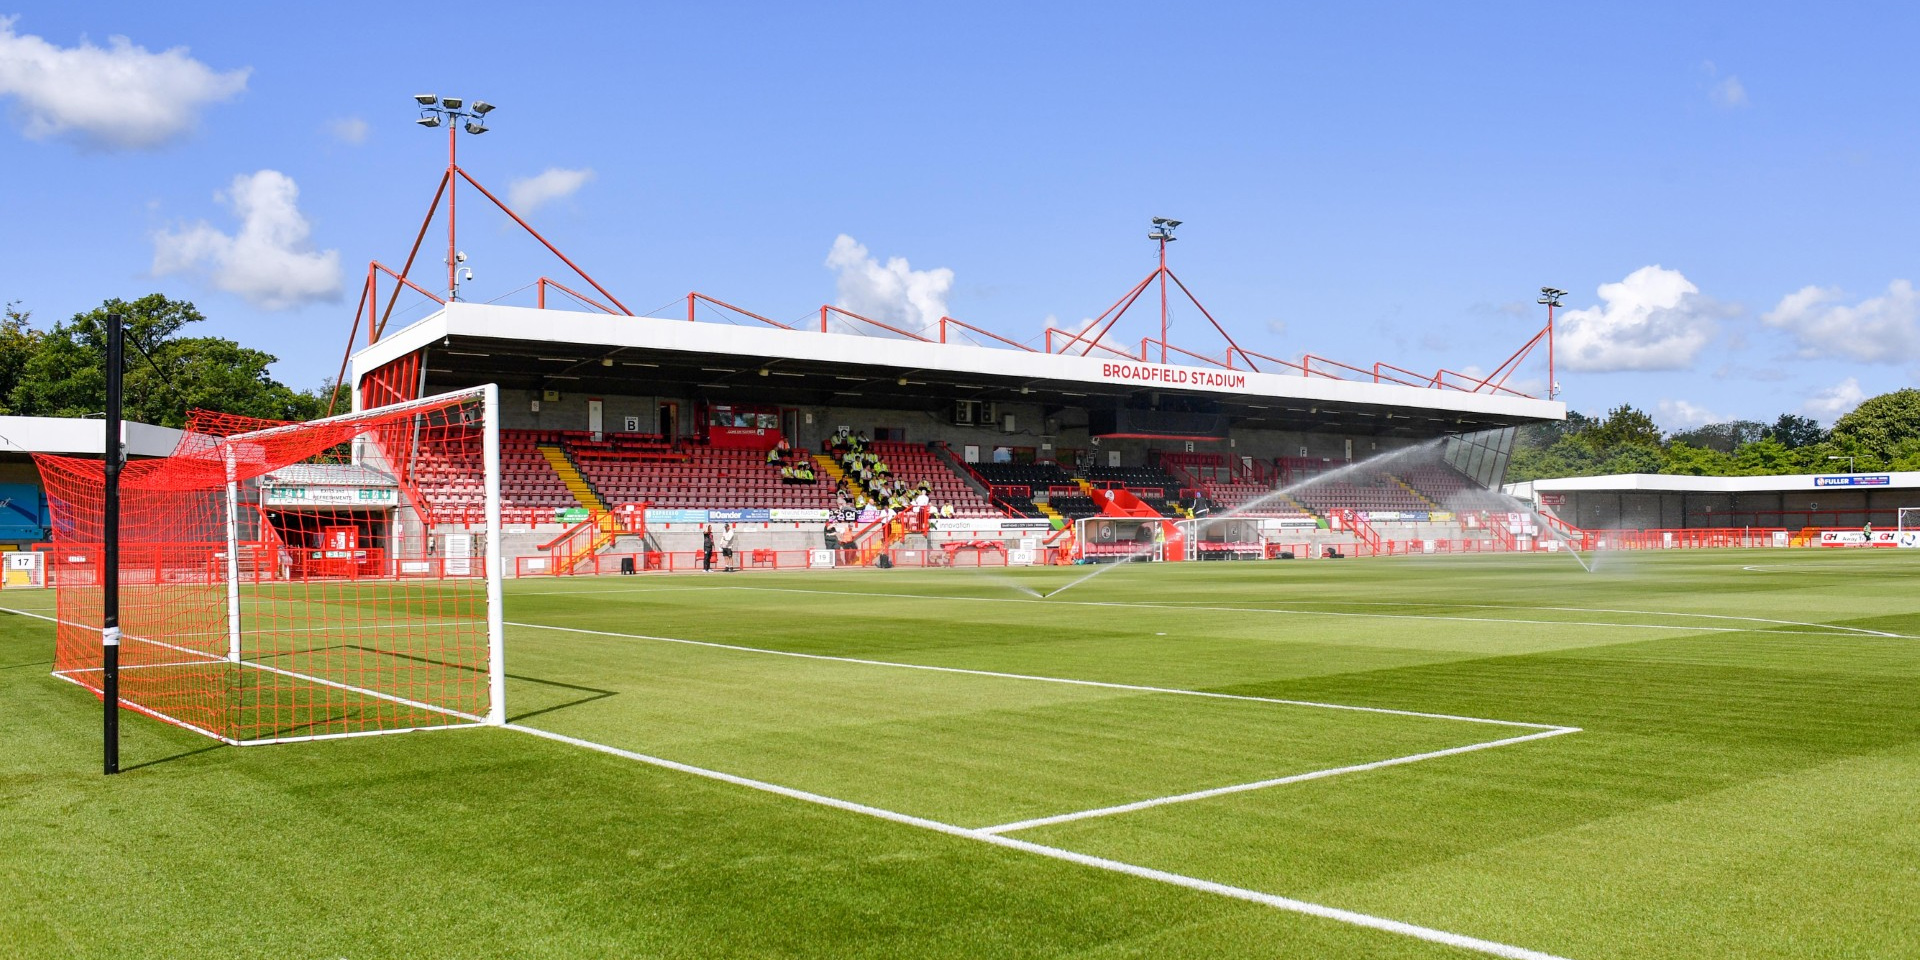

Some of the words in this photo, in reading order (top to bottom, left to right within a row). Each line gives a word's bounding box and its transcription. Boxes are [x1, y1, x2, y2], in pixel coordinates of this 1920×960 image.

[1103, 363, 1188, 383] BROADFIELD
[1191, 371, 1245, 388] STADIUM
[463, 413, 472, 425] A
[627, 420, 636, 431] B
[840, 429, 848, 439] C
[715, 511, 742, 519] Oander
[940, 521, 971, 529] innovation
[1823, 533, 1838, 541] GH
[17, 558, 29, 566] 17
